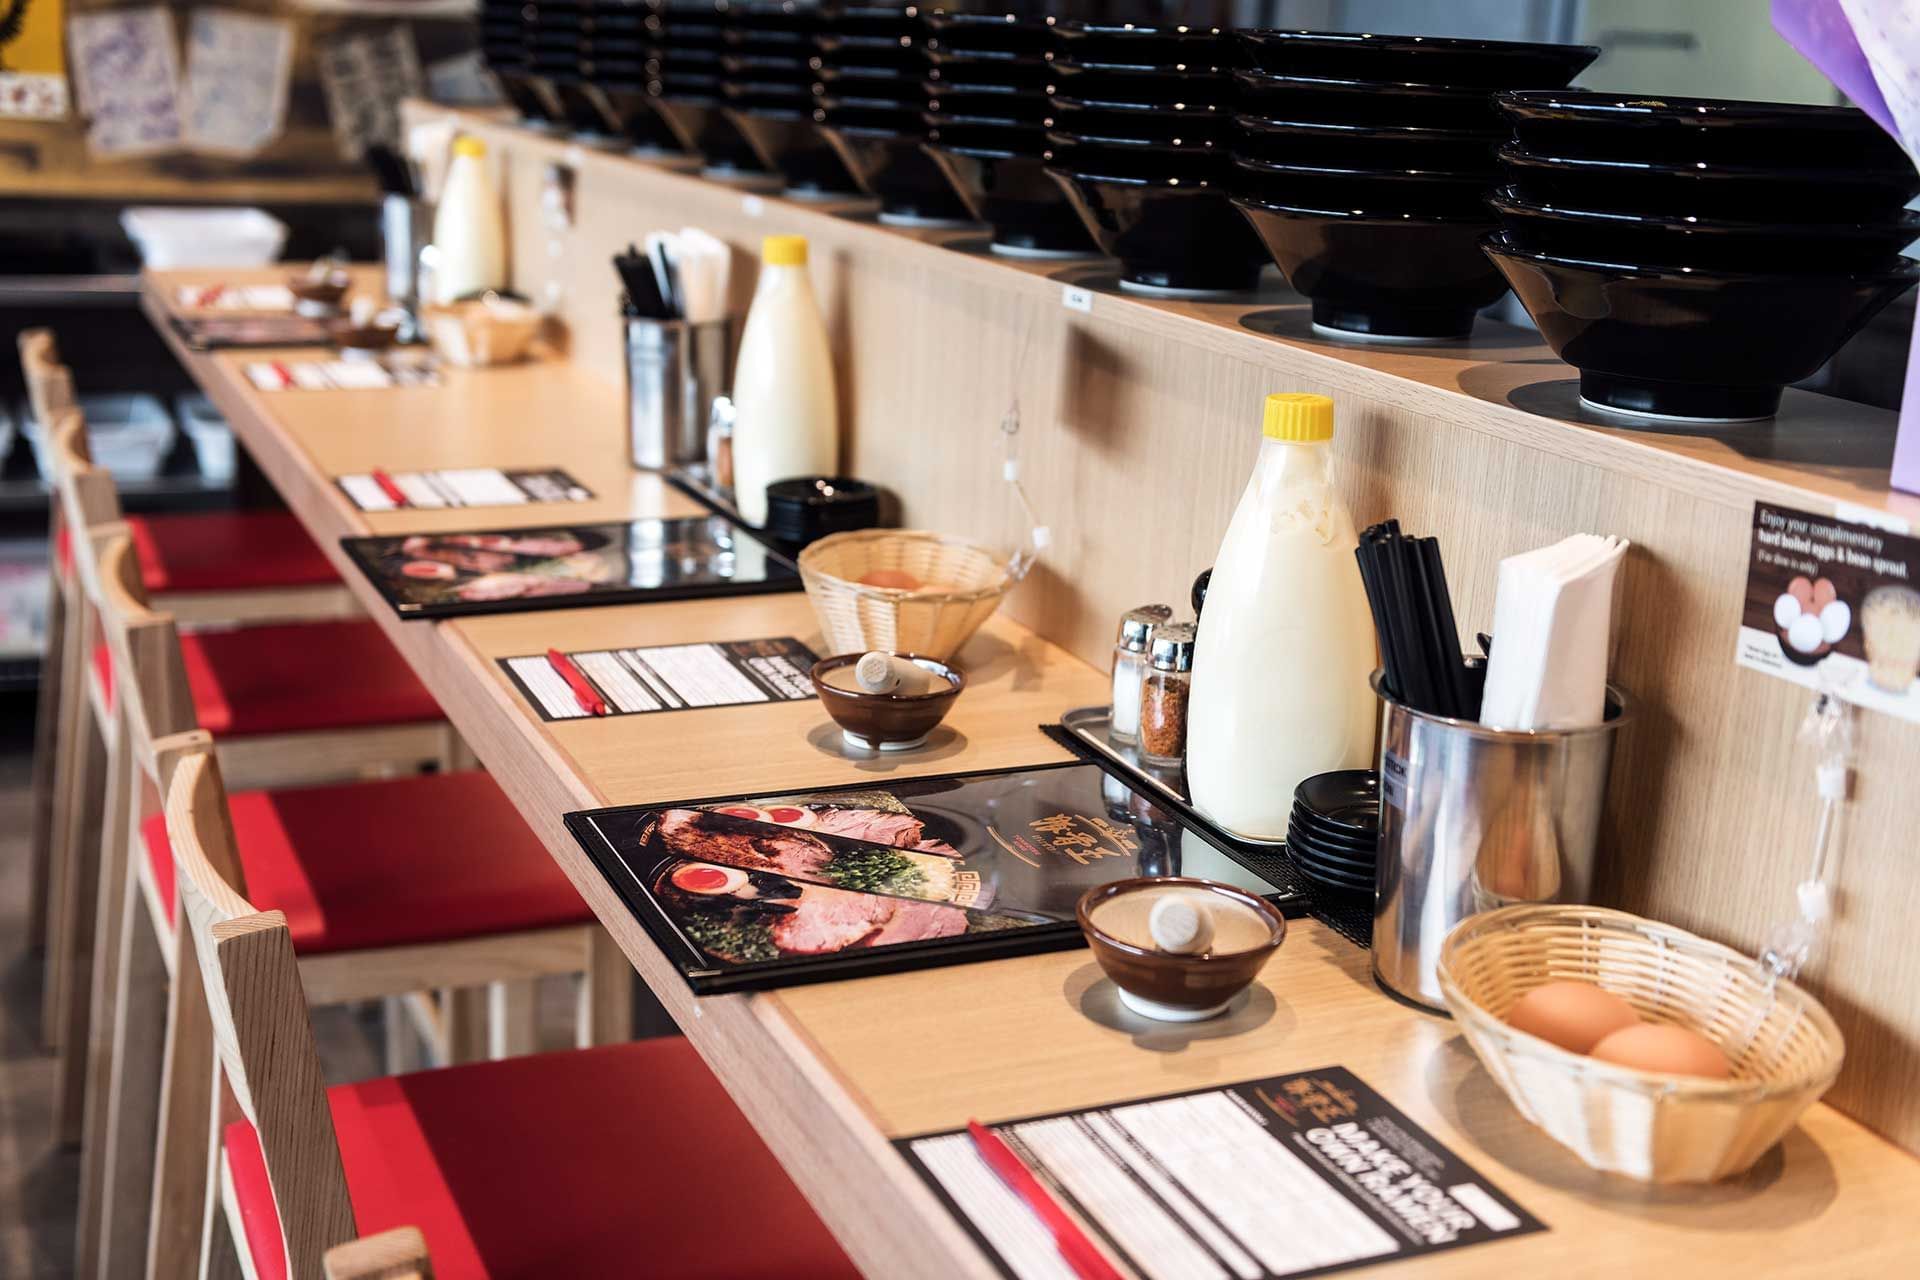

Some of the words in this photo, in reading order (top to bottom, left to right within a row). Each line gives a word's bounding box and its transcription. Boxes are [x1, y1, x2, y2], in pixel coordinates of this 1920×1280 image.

[1781, 533, 1811, 553] boiled
[1810, 522, 1883, 553] complimentary
[1305, 1127, 1377, 1174] OWN
[1356, 1168, 1458, 1245] RAMEN
[1331, 1121, 1412, 1179] MAKE
[1399, 1172, 1477, 1230] YOUR
